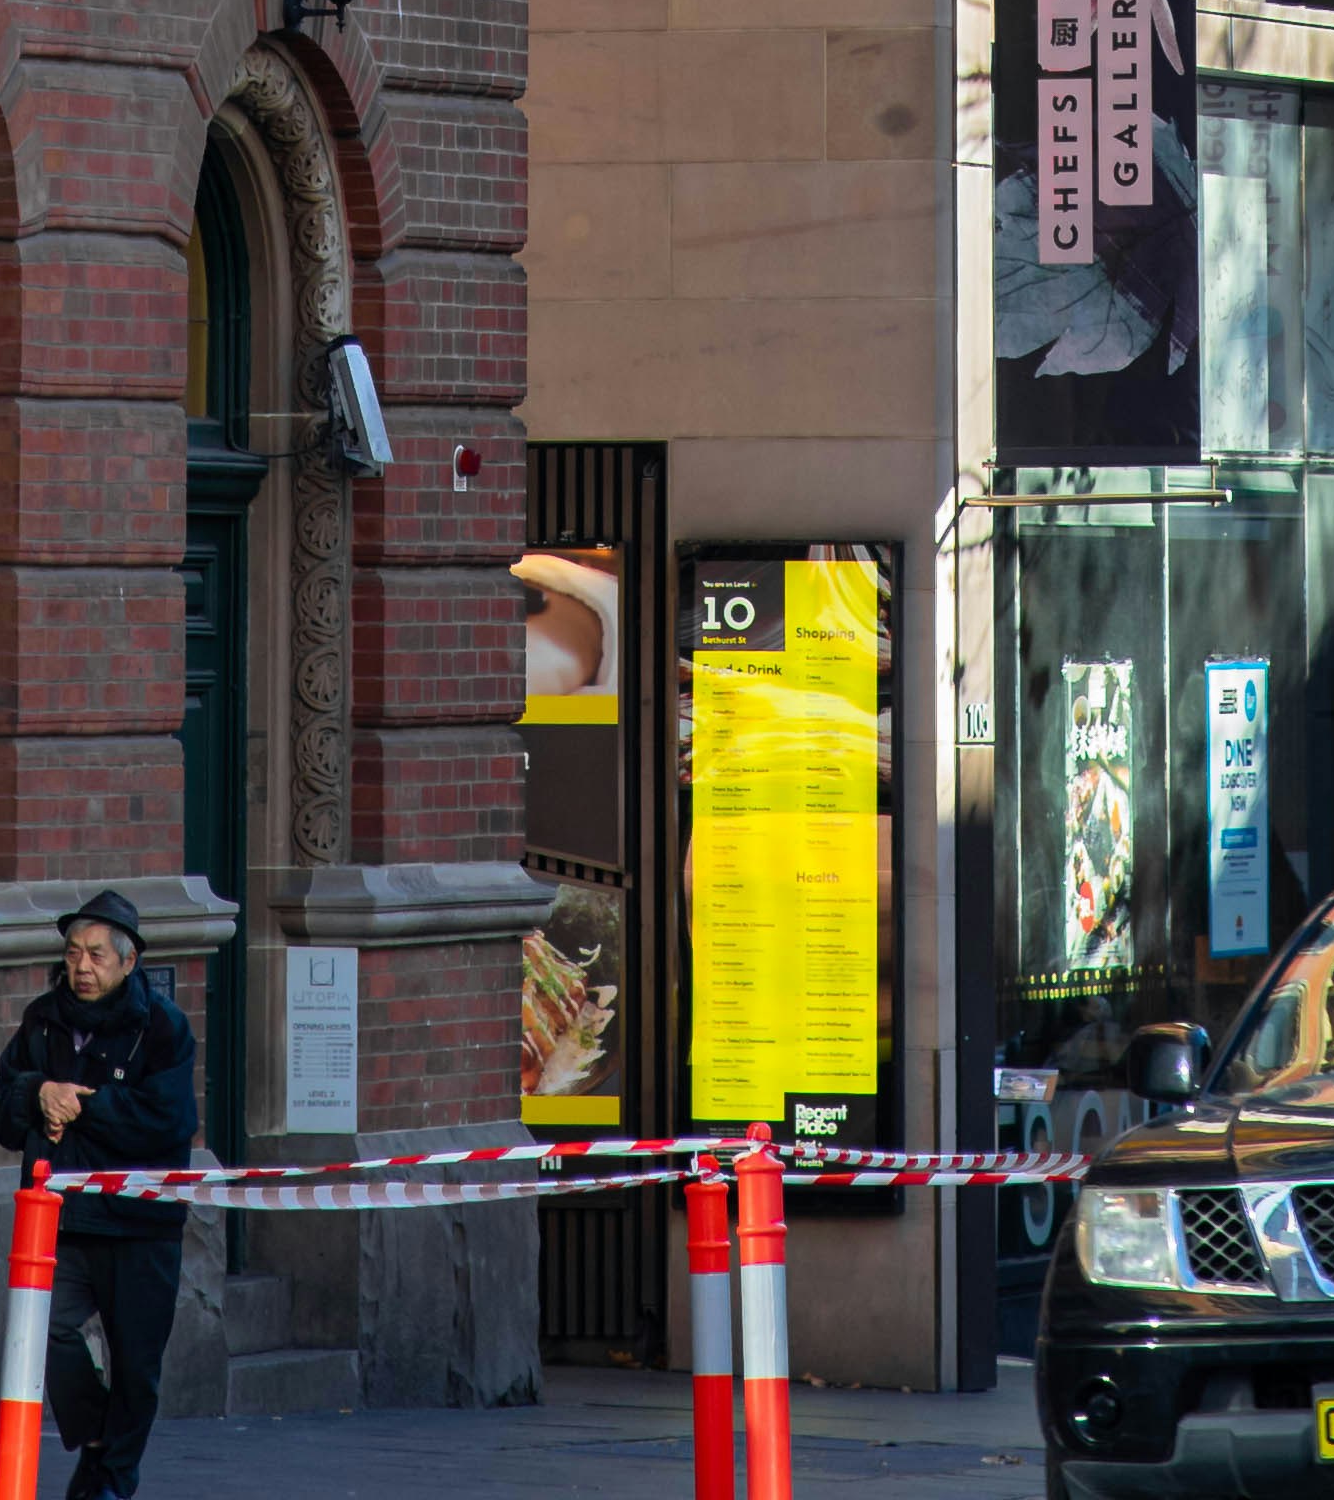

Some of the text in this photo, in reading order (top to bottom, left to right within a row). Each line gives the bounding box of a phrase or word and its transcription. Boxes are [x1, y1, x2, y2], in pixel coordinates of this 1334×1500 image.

[1053, 94, 1078, 250] CHEFS
[702, 596, 756, 631] 10
[702, 635, 747, 645] Bathurst St
[796, 627, 855, 641] Shopping
[747, 664, 783, 676] Drink
[1225, 739, 1252, 767] DINE
[796, 871, 840, 884] Health
[795, 1104, 848, 1122] Regent
[795, 1119, 838, 1135] Place
